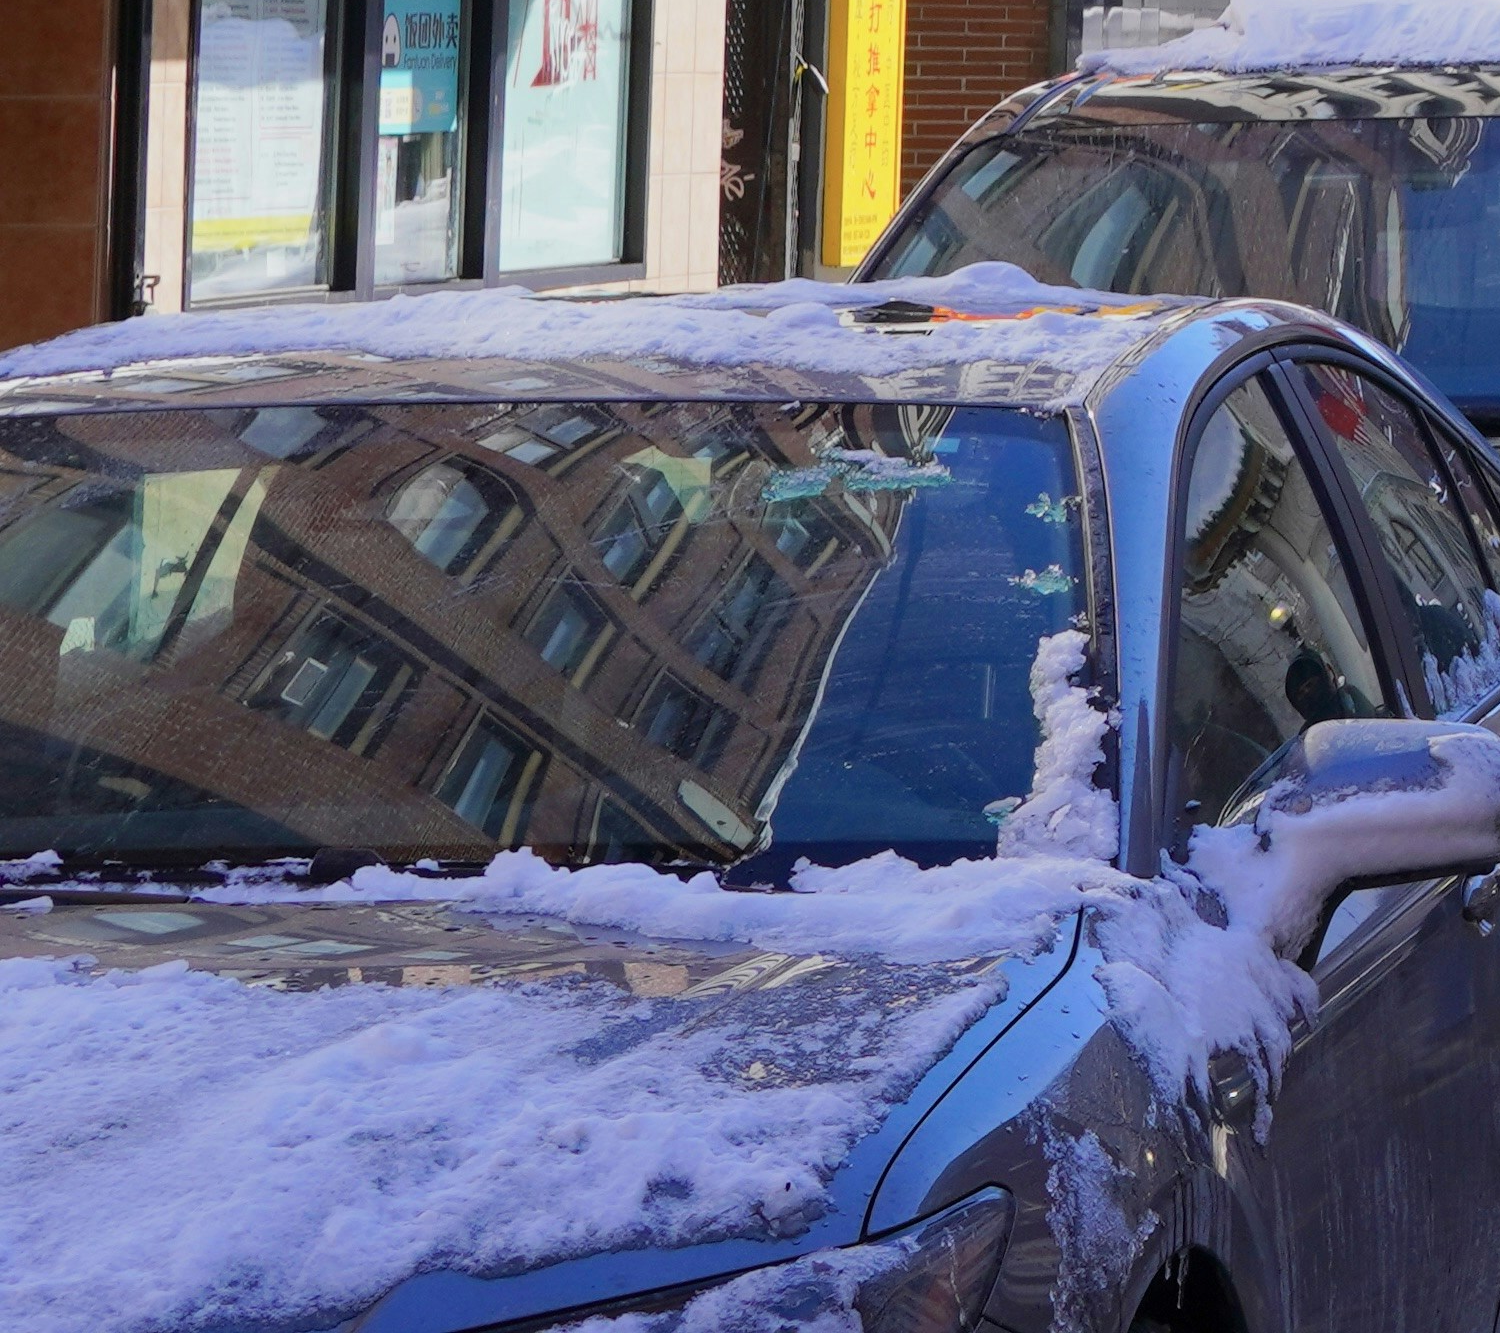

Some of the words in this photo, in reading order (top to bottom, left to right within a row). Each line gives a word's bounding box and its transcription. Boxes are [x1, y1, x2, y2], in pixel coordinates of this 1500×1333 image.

[404, 12, 458, 50] 饭团外卖
[431, 54, 456, 74] Delivery
